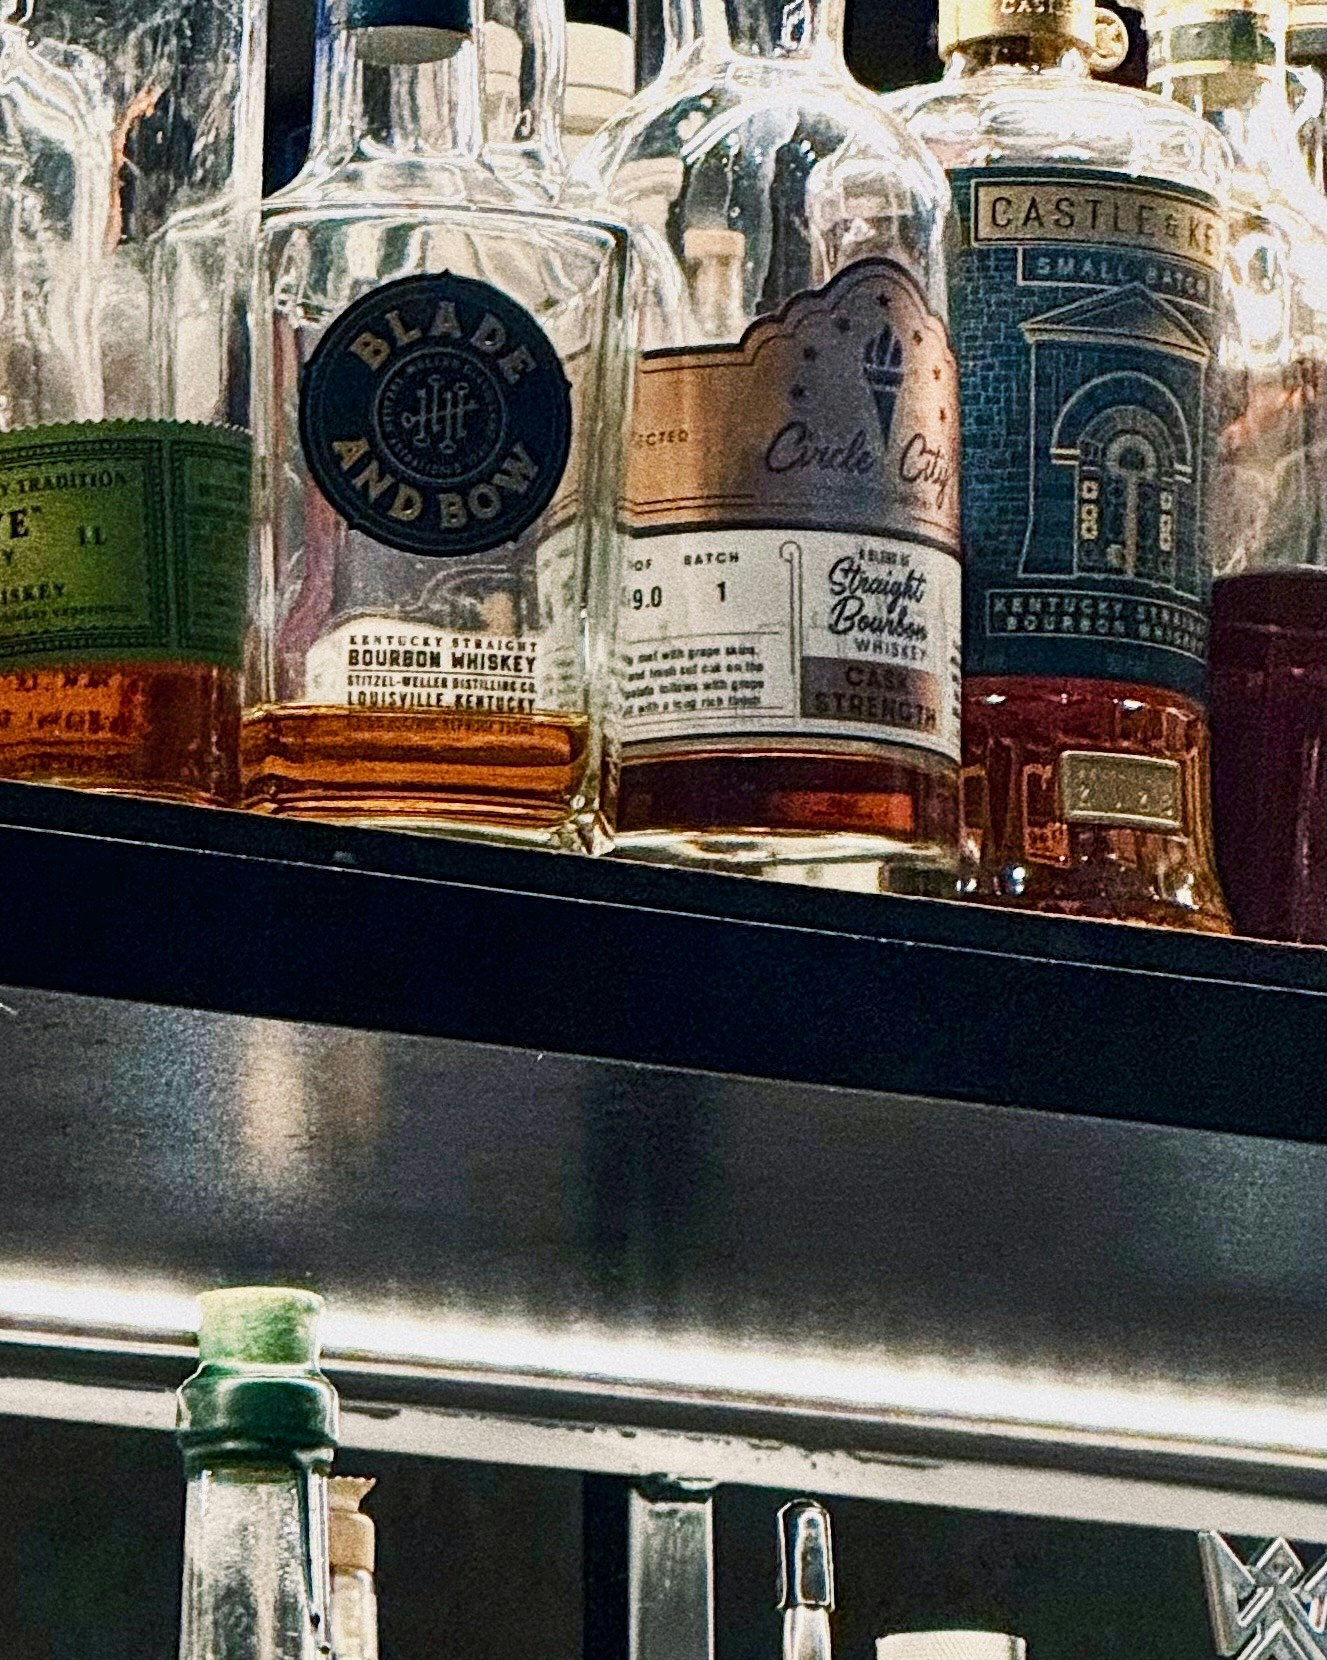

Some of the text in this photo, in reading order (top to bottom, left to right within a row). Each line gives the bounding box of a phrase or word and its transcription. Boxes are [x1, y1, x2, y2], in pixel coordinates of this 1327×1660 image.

[990, 196, 1155, 236] CASTLE
[1164, 213, 1179, 238] &
[1037, 257, 1132, 280] SMALL
[348, 300, 538, 385] BLADE
[765, 420, 952, 510] Circle City
[17, 470, 127, 495] TRADITION
[331, 437, 422, 522] AND
[436, 440, 540, 530] BOW
[684, 552, 740, 567] BATCH
[716, 581, 727, 603] 1
[828, 556, 927, 614] Straight
[827, 595, 928, 642] Bourbon
[994, 597, 1125, 615] KENTUCKY
[1006, 615, 1125, 634] BOURBON
[349, 635, 538, 653] KENTUCKY STRAIGHT
[854, 637, 927, 661] WHISKEY
[348, 649, 537, 674] BOURBON WHISKEY
[347, 674, 448, 689] STITZEL-WELLER
[845, 665, 908, 690] CASK
[454, 693, 536, 713] KENTUCKY
[814, 691, 937, 729] STRENGTH
